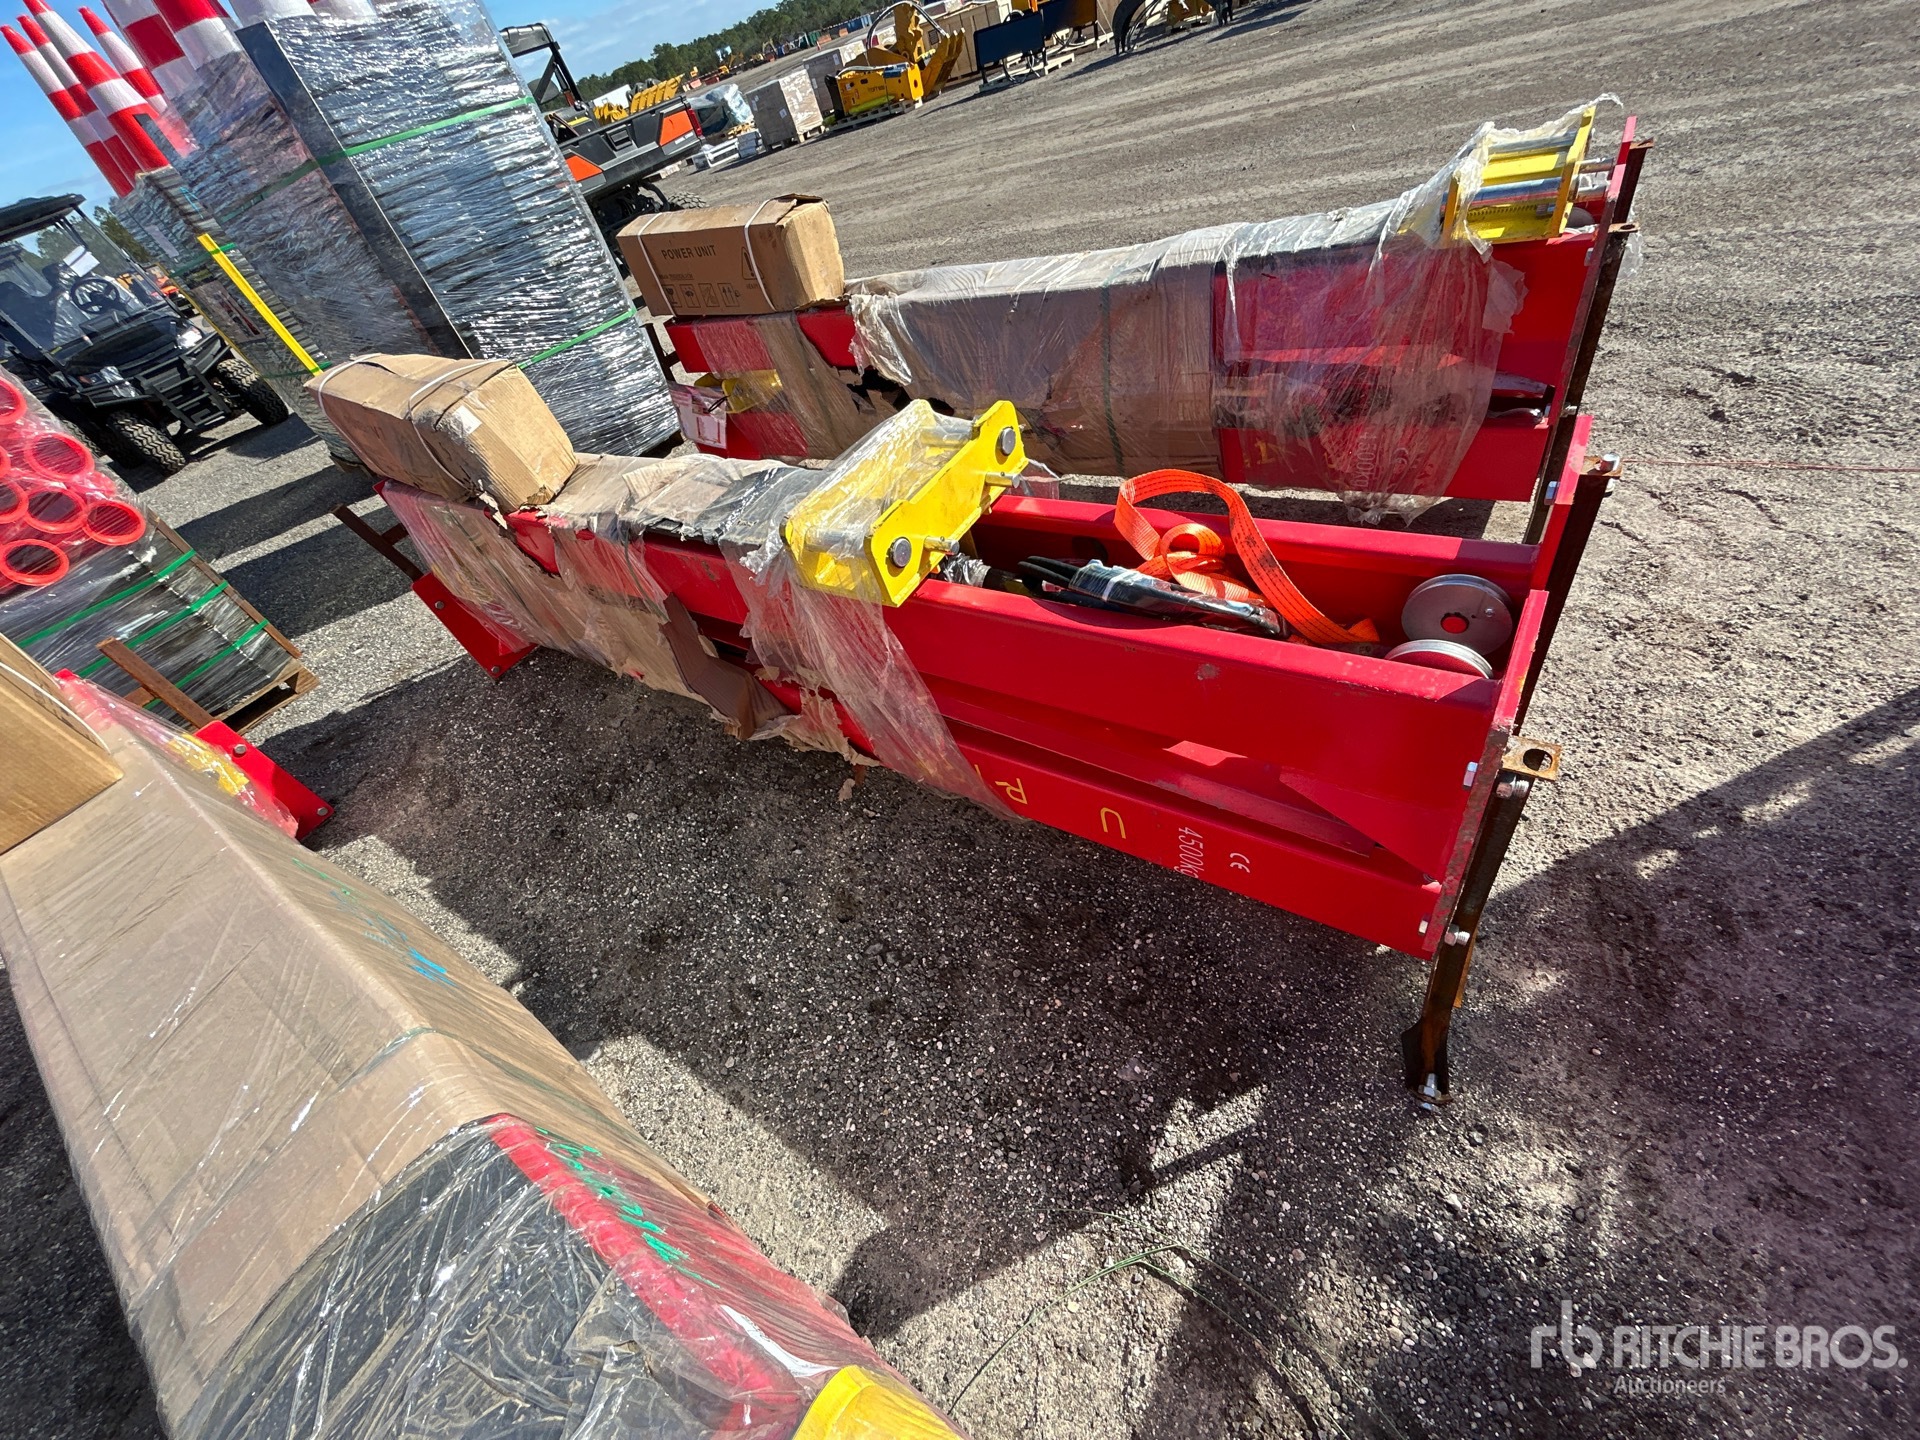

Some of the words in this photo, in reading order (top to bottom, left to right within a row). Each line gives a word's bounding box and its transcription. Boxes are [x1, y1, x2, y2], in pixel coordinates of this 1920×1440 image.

[661, 247, 694, 260] POWER
[694, 245, 717, 258] UNIT
[1174, 826, 1205, 879] 4500kg
[1229, 852, 1251, 873] CE
